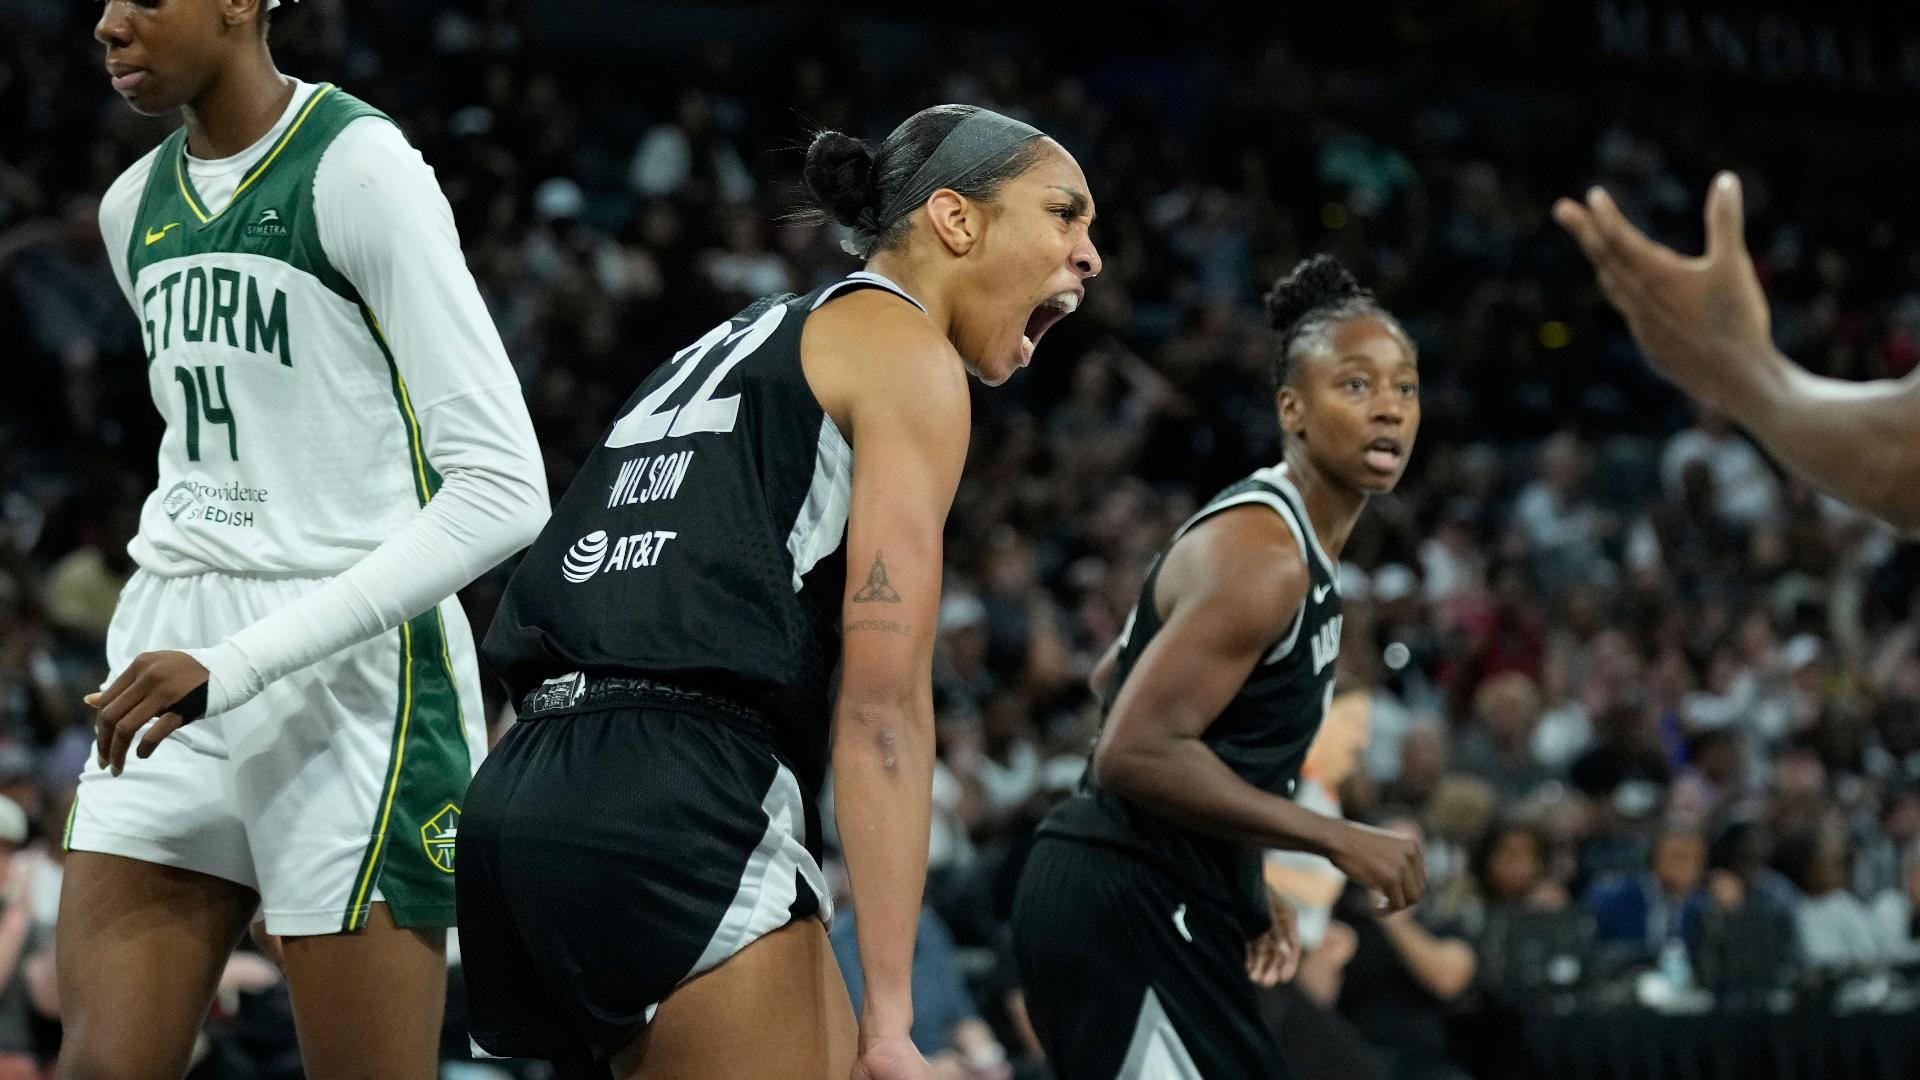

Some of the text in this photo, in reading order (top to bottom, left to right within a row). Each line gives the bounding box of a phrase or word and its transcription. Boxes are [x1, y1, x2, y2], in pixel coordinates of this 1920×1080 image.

[247, 225, 287, 237] SYMETRA
[142, 266, 293, 368] STORM
[175, 366, 238, 461] 14
[604, 304, 787, 448] 22
[607, 450, 694, 509] WILSON
[604, 531, 677, 573] AT&T
